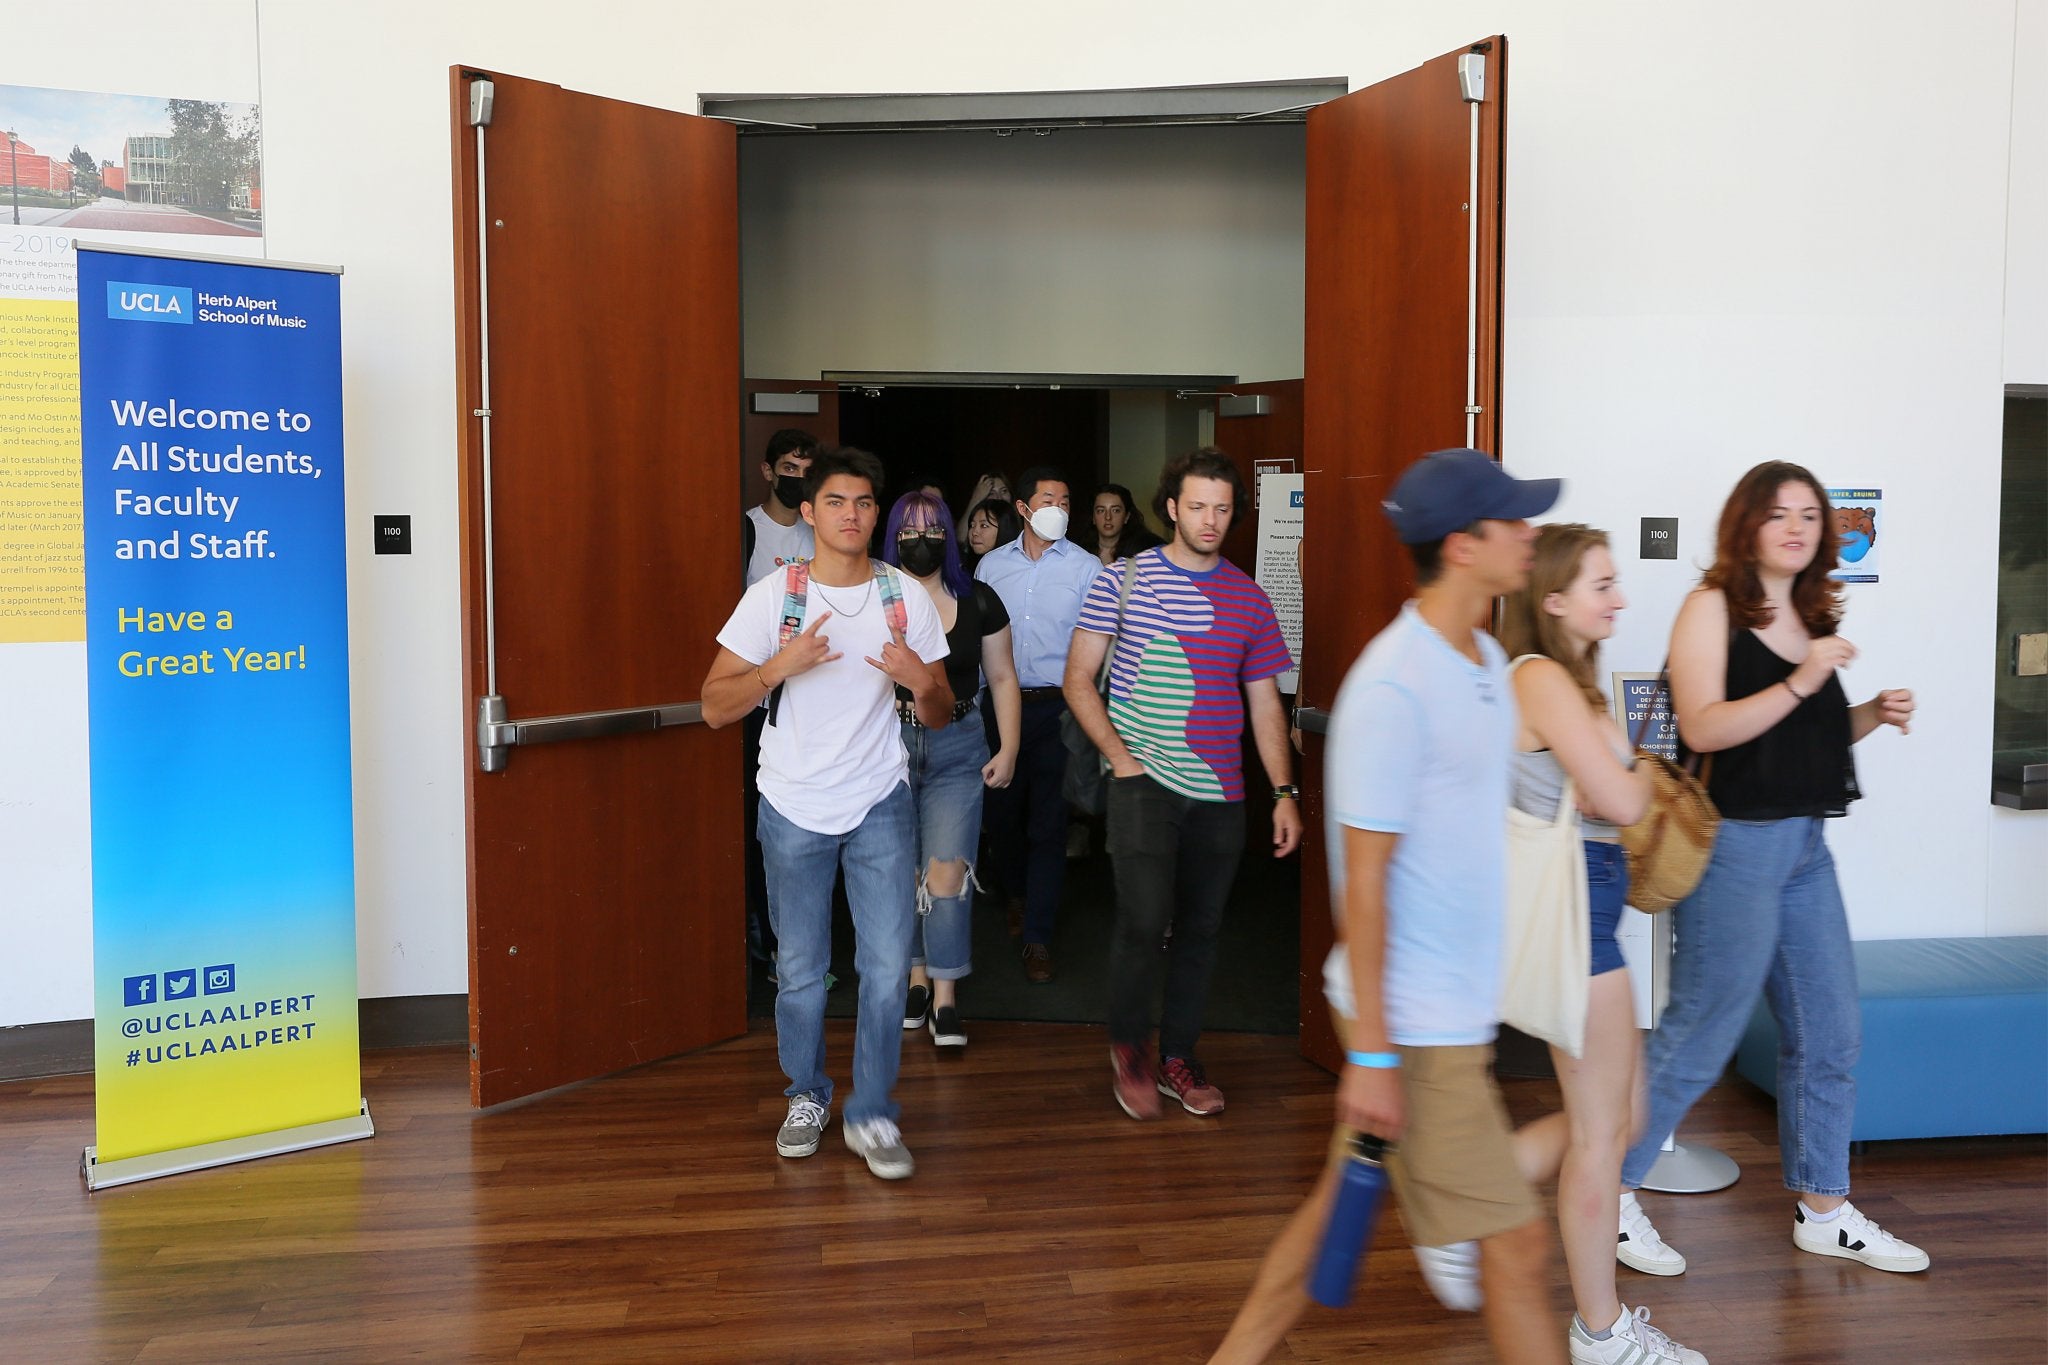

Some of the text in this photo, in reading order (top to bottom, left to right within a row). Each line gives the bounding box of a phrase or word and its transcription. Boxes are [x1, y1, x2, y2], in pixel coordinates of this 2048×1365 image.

[15, 259, 37, 267] three
[22, 271, 35, 280] gift
[37, 272, 56, 280] from
[120, 291, 181, 314] UCLA
[198, 292, 277, 311] Herb Alpert
[25, 314, 51, 323] Monk
[198, 309, 307, 329] School of Music
[11, 326, 69, 337] collaborating
[17, 338, 36, 347] level
[39, 341, 76, 349] program
[31, 352, 67, 360] Institute
[69, 352, 78, 360] of
[5, 369, 79, 380] Industry Program
[36, 382, 48, 390] for
[9, 413, 26, 421] and
[27, 413, 42, 421] Mo
[44, 413, 68, 421] Ostin
[110, 398, 312, 433] Welcome to
[29, 425, 65, 434] includes
[3, 437, 20, 445] and
[21, 438, 62, 447] teaching,
[22, 456, 60, 464] establish
[111, 441, 322, 479] All Students,
[24, 469, 65, 477] approved
[67, 469, 78, 477] by
[6, 480, 49, 488] Academic
[16, 500, 52, 508] approve
[115, 486, 239, 522] Faculty
[7, 511, 33, 519] Music
[48, 512, 81, 520] January
[8, 523, 27, 531] later
[29, 523, 61, 532] (March
[384, 527, 401, 536] 1100
[1650, 530, 1669, 539] 1100
[3, 541, 35, 551] degree
[37, 541, 45, 549] in
[47, 541, 74, 550] Global
[115, 529, 276, 560] and Staff.
[45, 555, 62, 563] jazz
[25, 566, 47, 574] from
[49, 566, 68, 574] 1996
[29, 608, 60, 616] second
[118, 606, 233, 633] Have a
[118, 644, 306, 677] Great Year!
[1660, 724, 1676, 733] OF
[121, 994, 316, 1038] @UCLAALPERT
[126, 1022, 316, 1067] #UCLAALPERT
